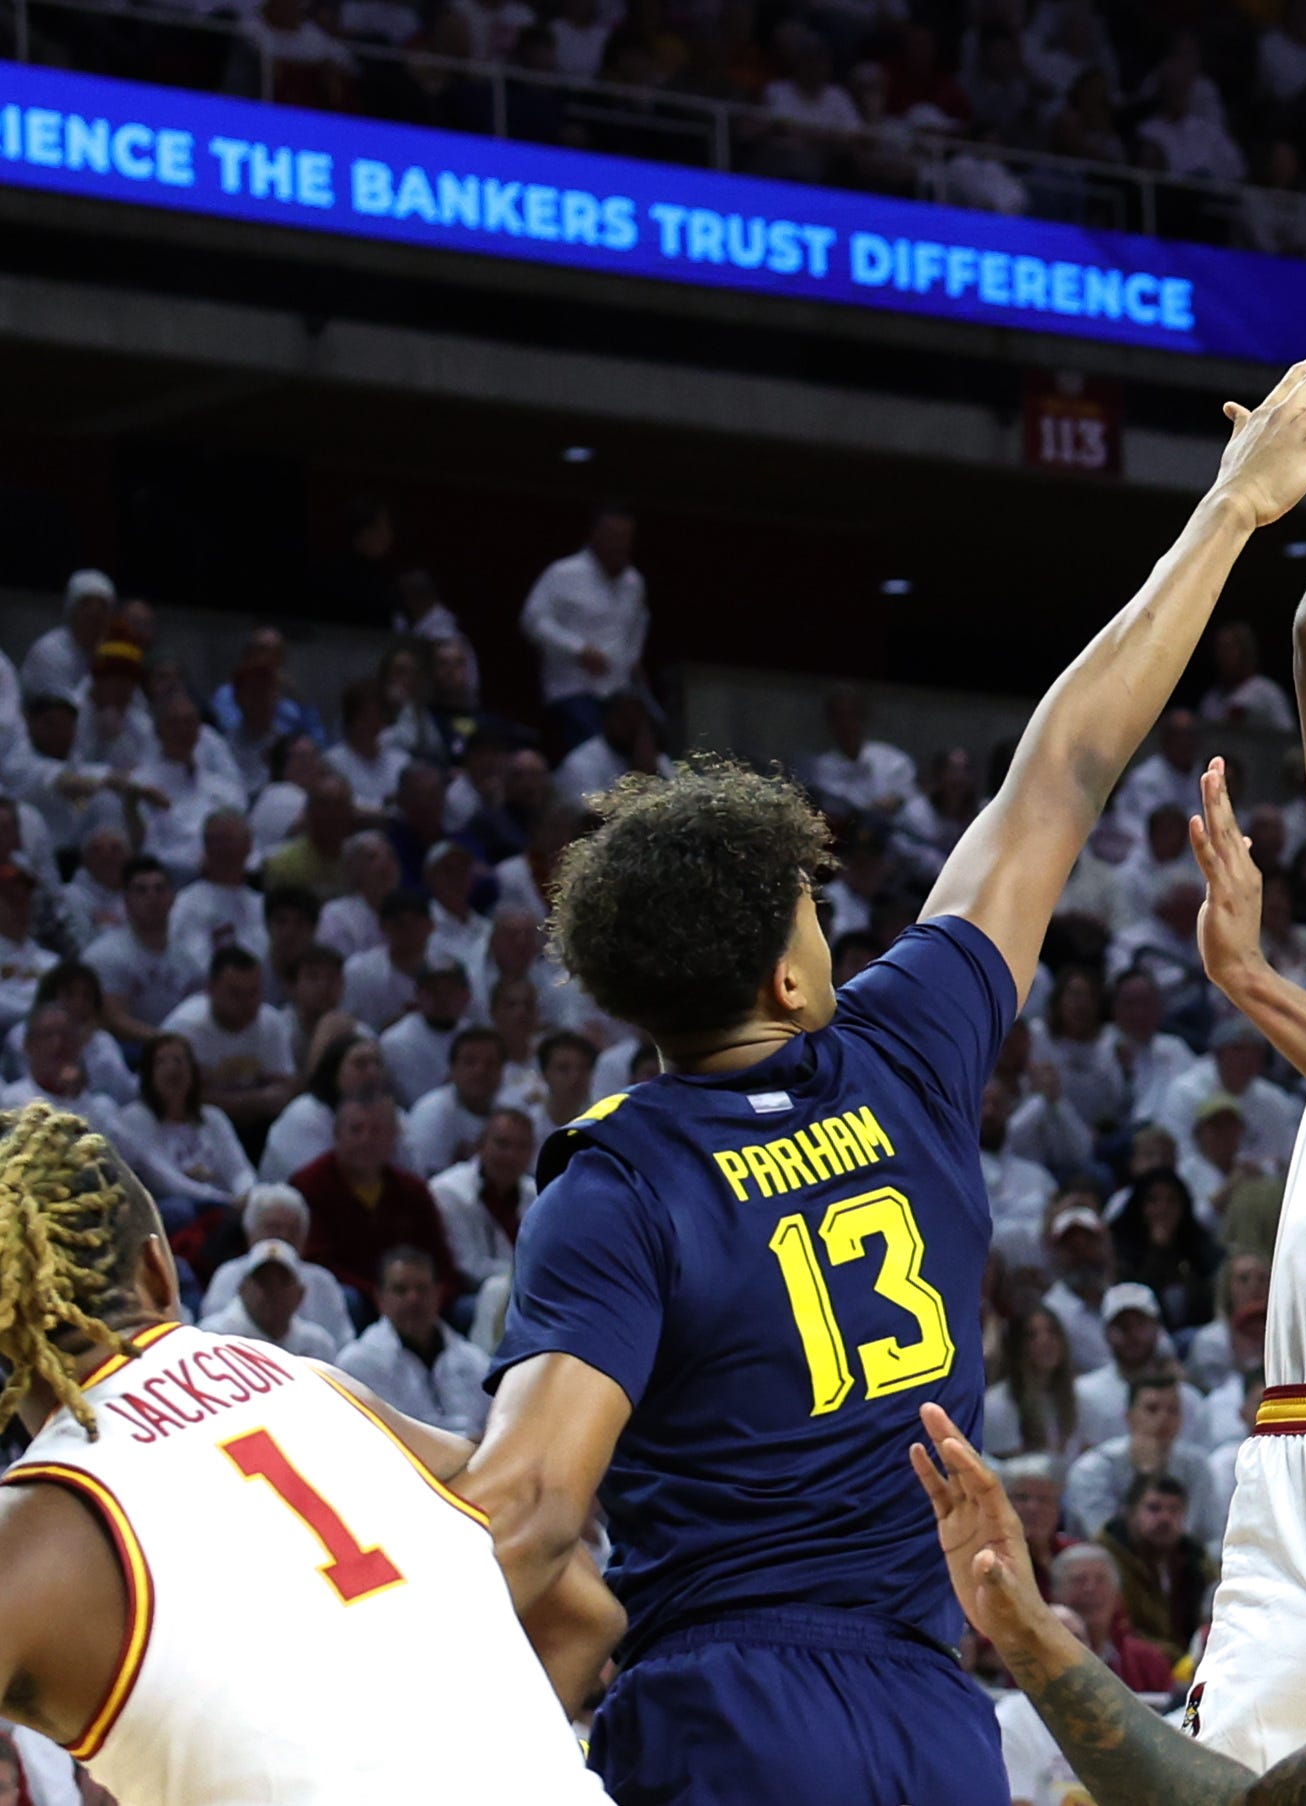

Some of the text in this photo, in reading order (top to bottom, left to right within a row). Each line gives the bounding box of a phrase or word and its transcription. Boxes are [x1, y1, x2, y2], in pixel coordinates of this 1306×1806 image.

[0, 102, 1196, 331] IENCE THE BANKERS TRUST DIFFERENCE
[1039, 415, 1107, 468] 113
[713, 1105, 896, 1202] PARHAM
[768, 1186, 956, 1417] 13
[104, 1341, 295, 1444] JACKSON
[214, 1424, 409, 1608] 1
